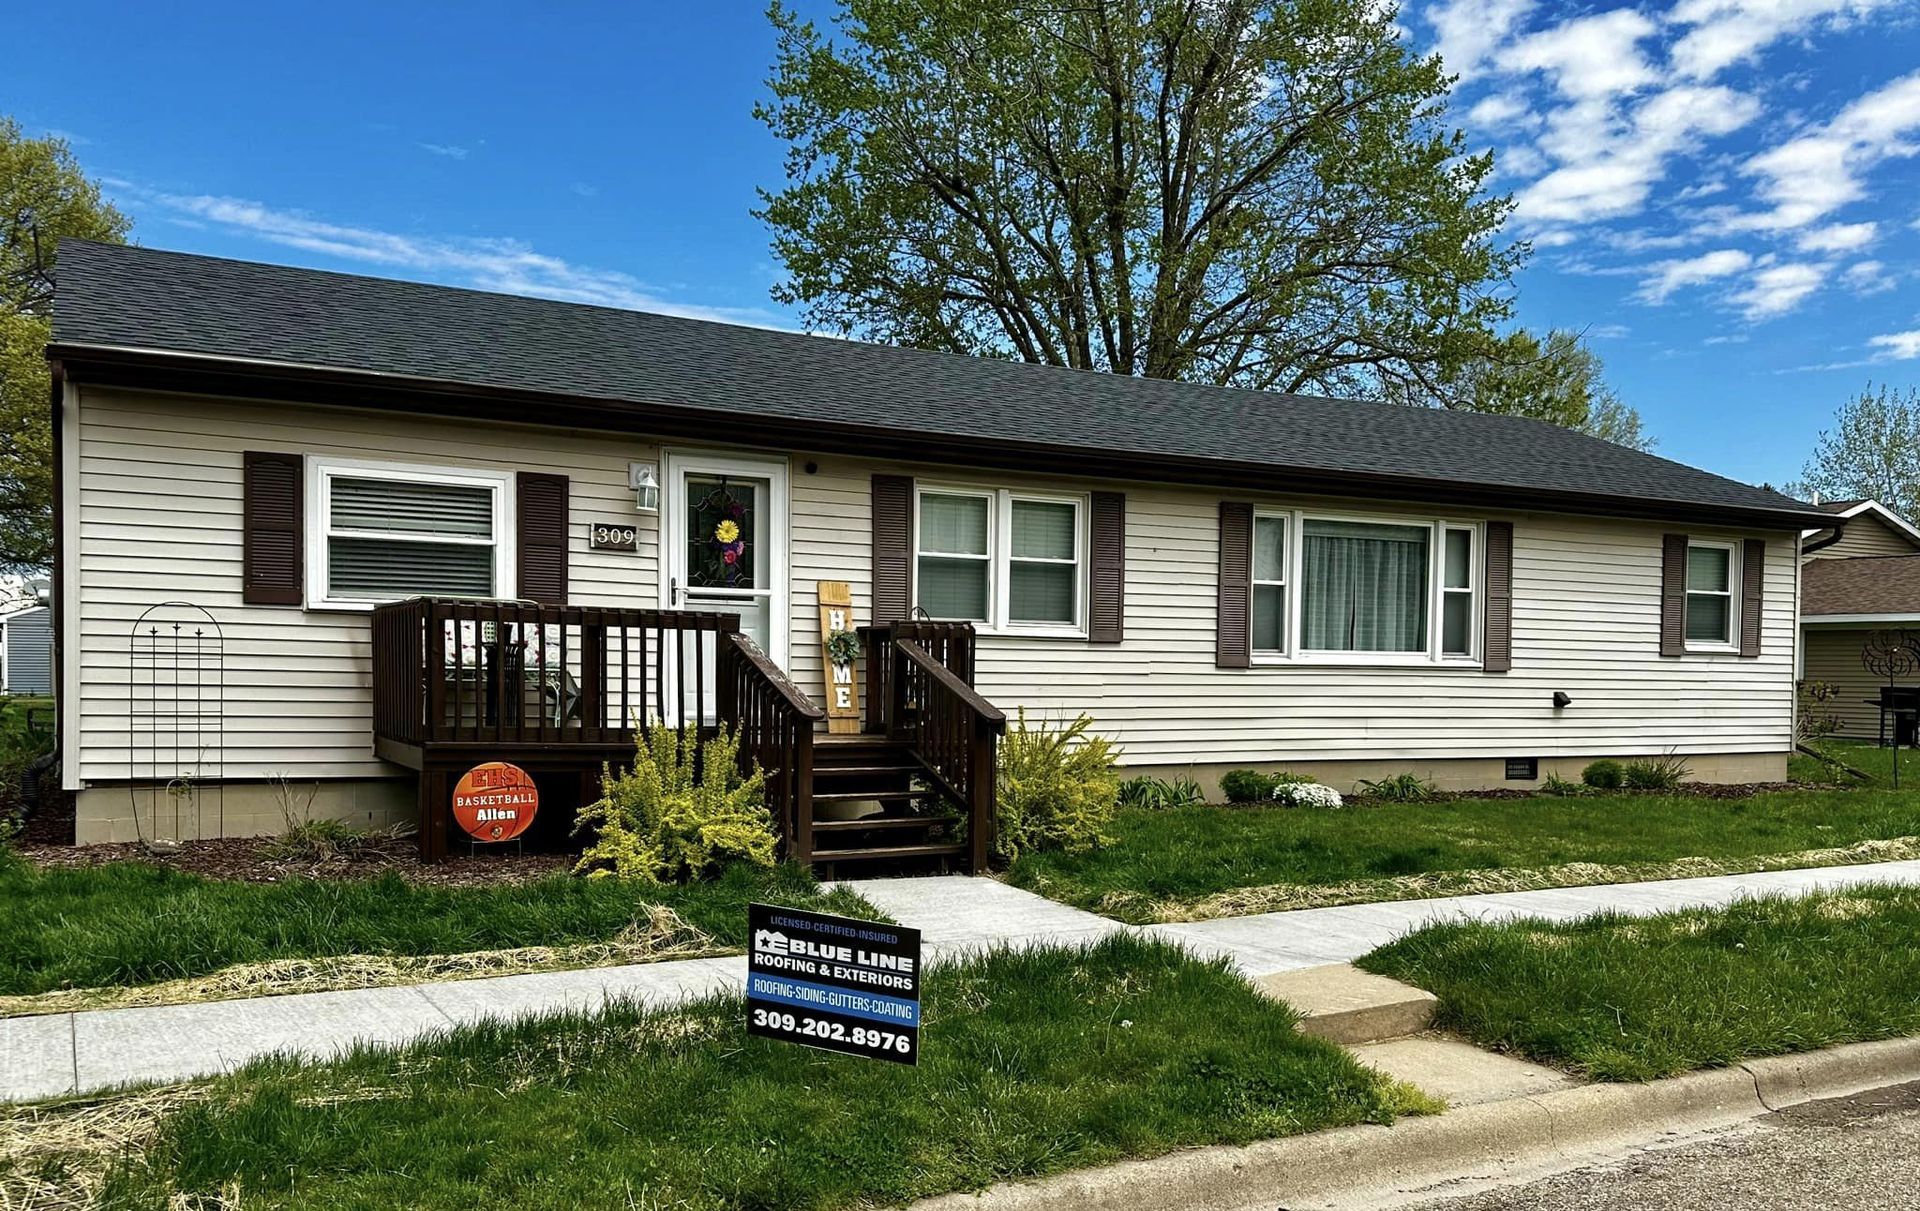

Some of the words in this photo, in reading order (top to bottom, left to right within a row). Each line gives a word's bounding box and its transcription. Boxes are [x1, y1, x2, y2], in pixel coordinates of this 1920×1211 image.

[598, 527, 634, 545] 309
[471, 768, 519, 788] EHS
[456, 793, 535, 807] BASKETBALL
[476, 808, 516, 821] Allen
[789, 938, 852, 962] BLUE
[857, 950, 914, 973] LINE
[754, 952, 816, 974] ROOFING
[819, 964, 831, 977] &
[834, 966, 913, 990] EXTERIORS
[753, 1008, 911, 1053] 309.202.8976
